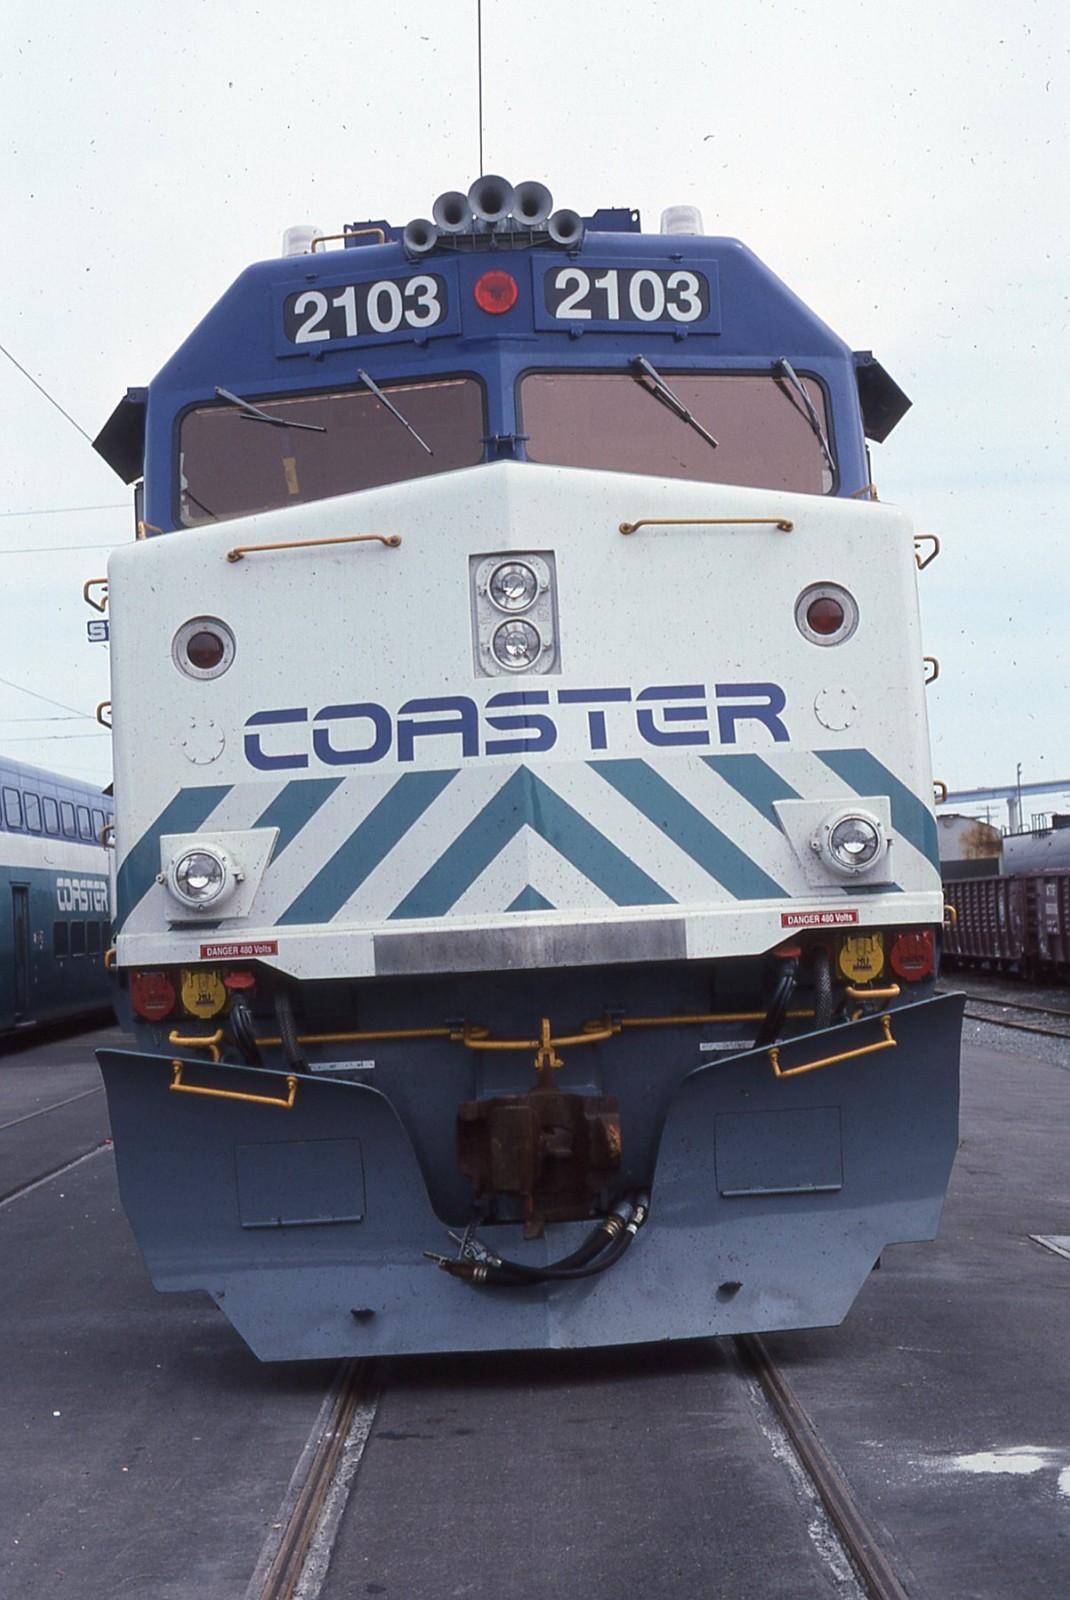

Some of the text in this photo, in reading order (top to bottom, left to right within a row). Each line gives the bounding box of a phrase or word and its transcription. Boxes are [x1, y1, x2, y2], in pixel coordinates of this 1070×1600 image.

[294, 275, 441, 344] 2103
[555, 268, 702, 322] 2103
[244, 682, 790, 771] COASTER
[57, 878, 108, 912] COASTER
[788, 914, 820, 925] DANGER
[836, 912, 853, 922] Volts
[206, 944, 272, 957] DANGER 480 Volts
